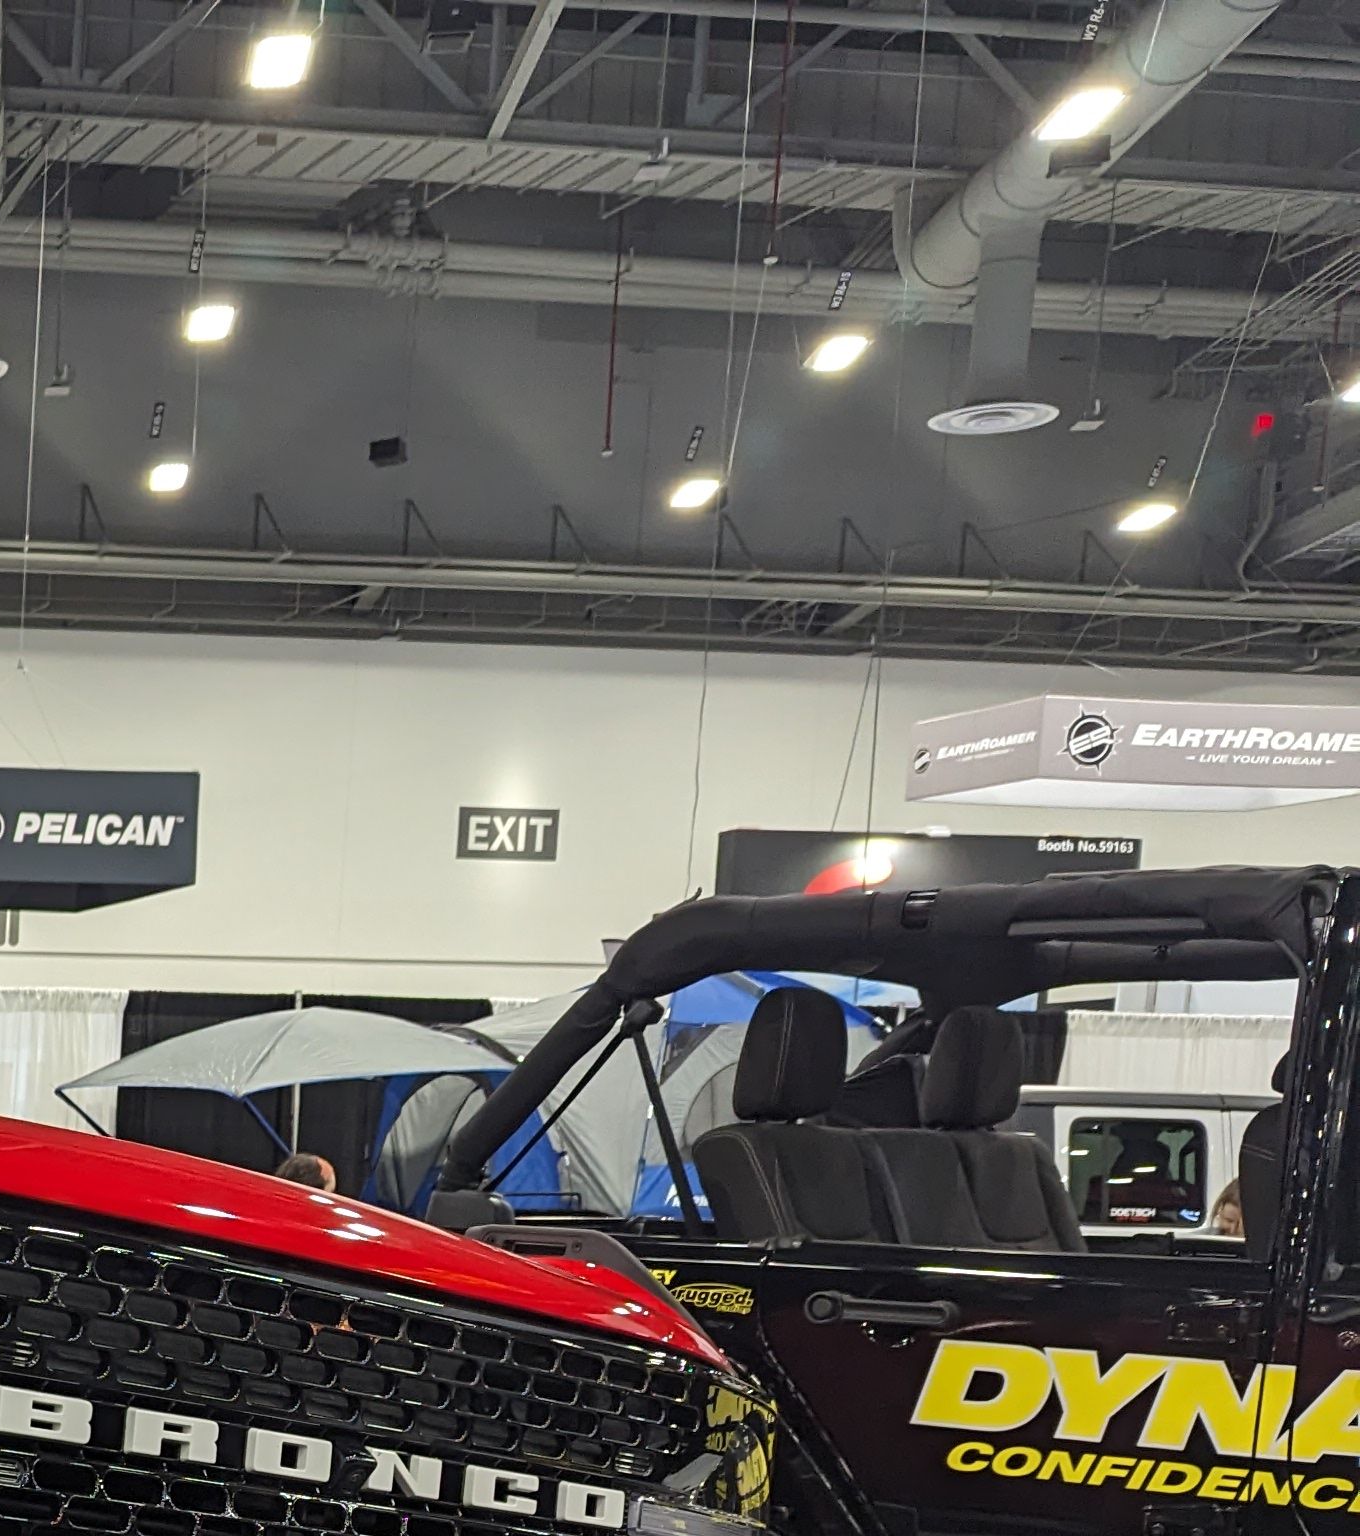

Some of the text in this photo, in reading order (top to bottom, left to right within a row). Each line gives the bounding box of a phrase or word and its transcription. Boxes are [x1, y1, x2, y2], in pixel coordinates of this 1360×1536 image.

[1199, 753, 1322, 766] LIVE YOUR DREAM
[13, 812, 176, 847] PELICAN
[467, 815, 553, 853] EXIT
[1038, 839, 1134, 854] Booth No.59163
